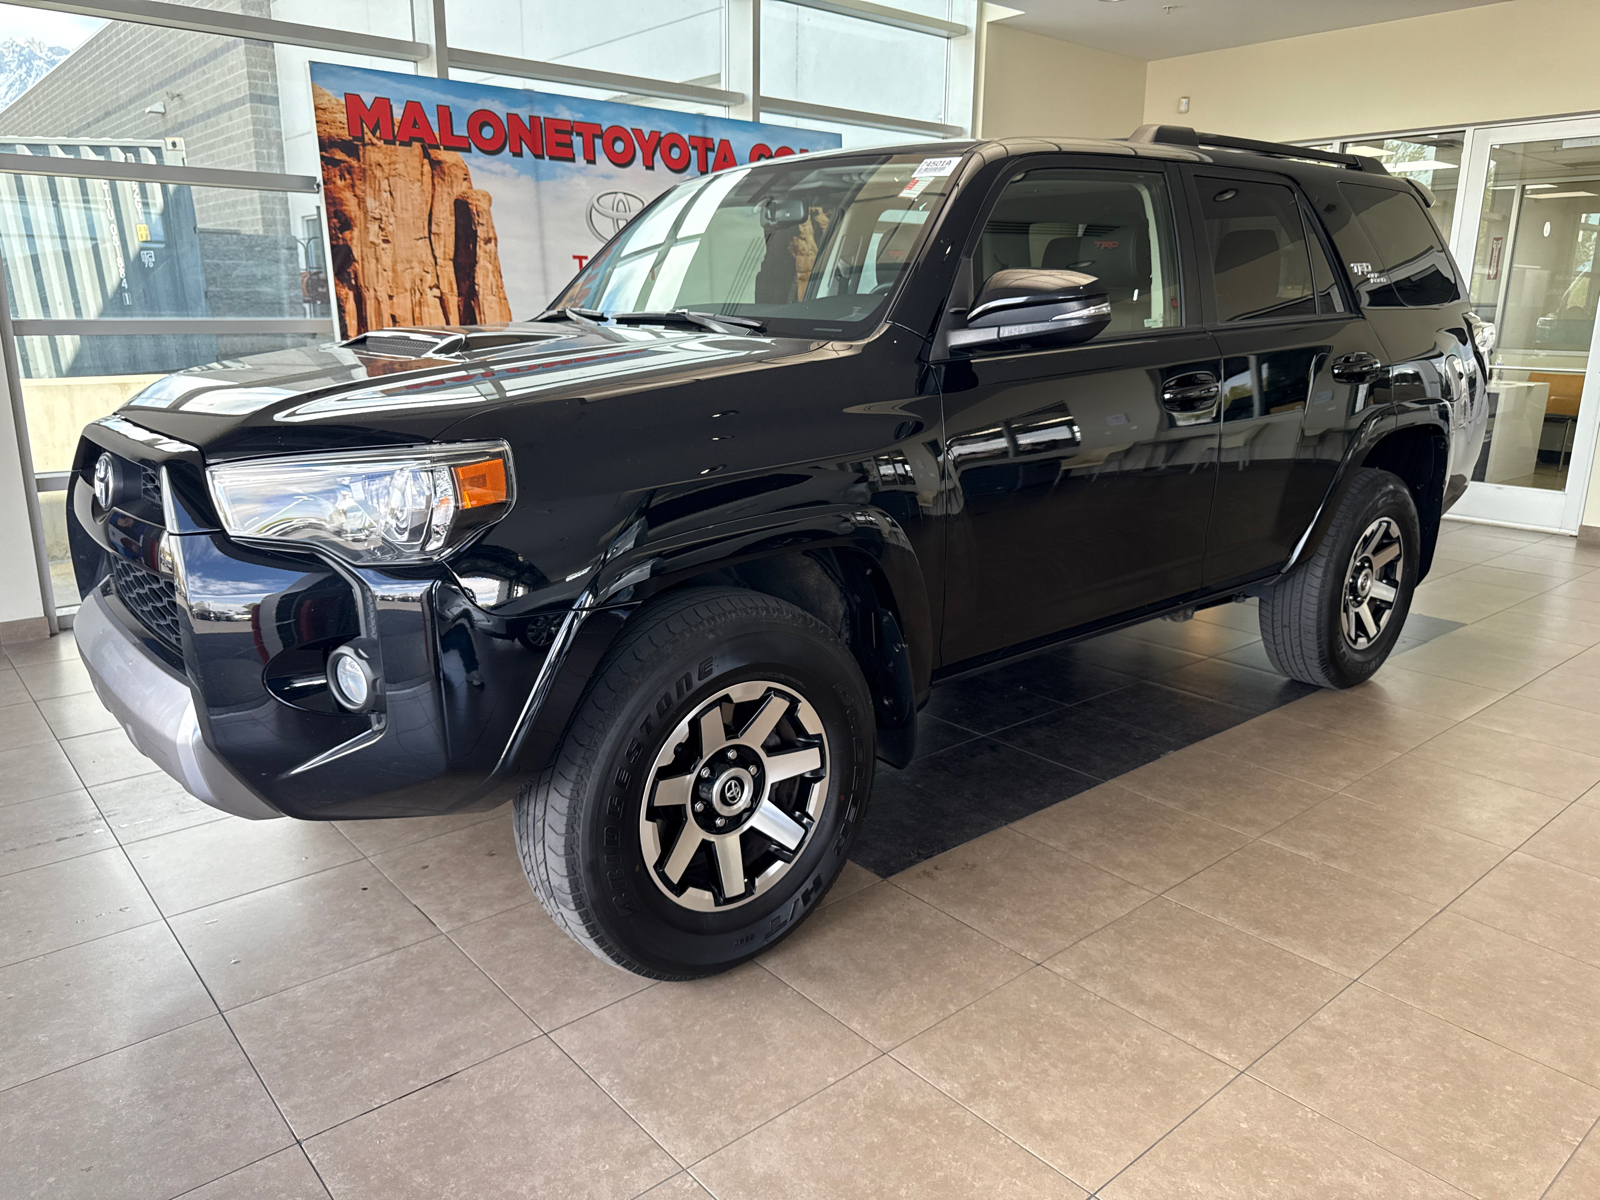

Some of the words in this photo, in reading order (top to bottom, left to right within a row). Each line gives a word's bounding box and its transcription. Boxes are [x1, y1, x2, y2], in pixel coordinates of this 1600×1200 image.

[344, 93, 809, 173] MALONETOYOTAC
[1094, 240, 1119, 249] TRD
[1350, 263, 1372, 275] TRD
